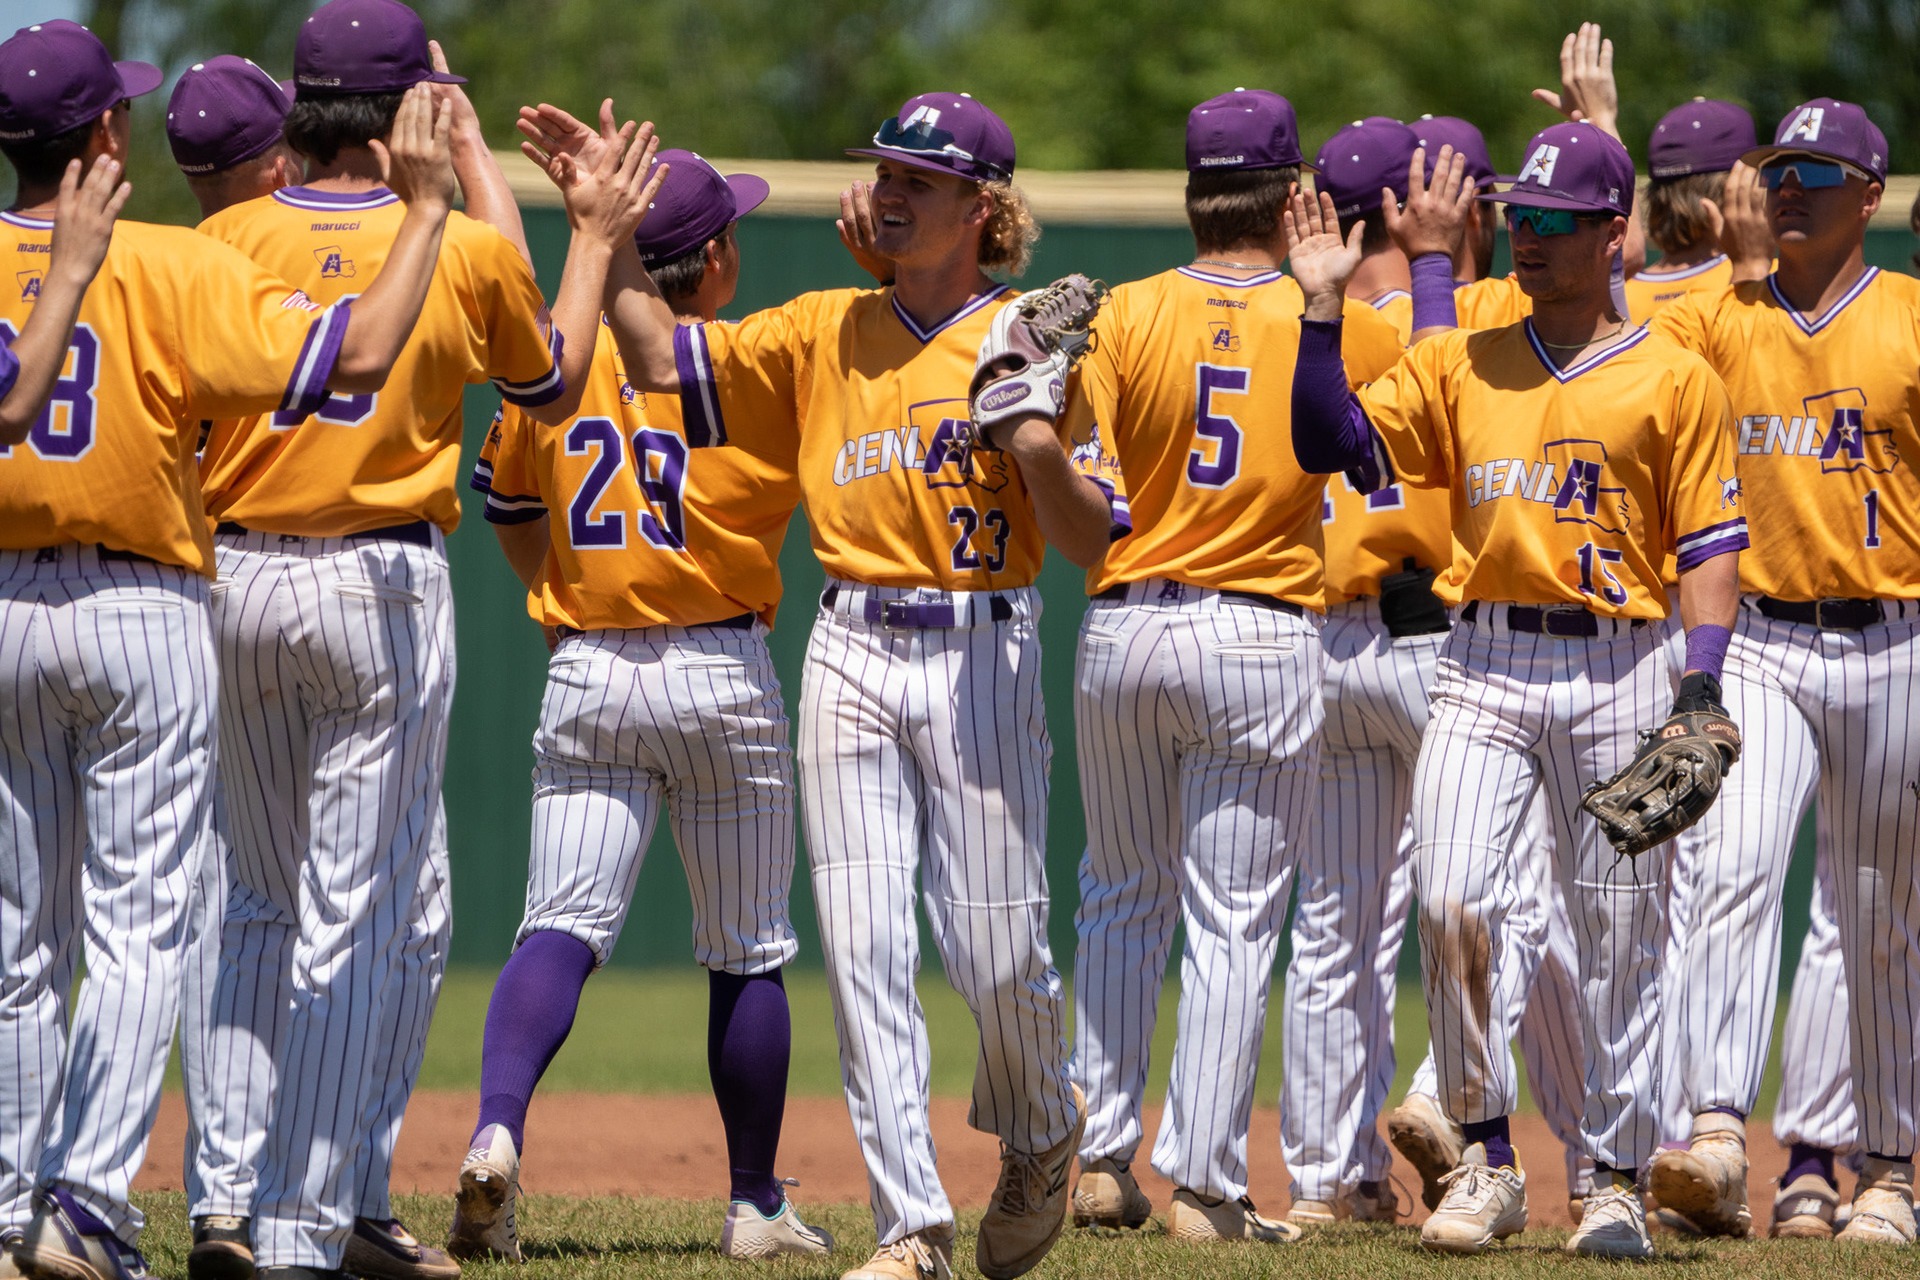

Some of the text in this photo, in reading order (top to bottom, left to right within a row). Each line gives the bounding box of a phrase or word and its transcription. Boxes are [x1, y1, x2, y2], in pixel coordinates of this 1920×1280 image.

[1517, 144, 1560, 187] A
[17, 243, 52, 253] maruc
[310, 221, 361, 231] marucci
[1206, 297, 1249, 310] marucci
[0, 318, 101, 462] 8
[984, 387, 1029, 410] Wilson
[1187, 362, 1252, 490] 5
[1737, 408, 1866, 462] ENLA
[564, 417, 690, 551] 29
[1464, 459, 1602, 517] CENLA
[948, 506, 1011, 573] 23
[1863, 488, 1881, 549] 1
[1576, 542, 1628, 607] 15
